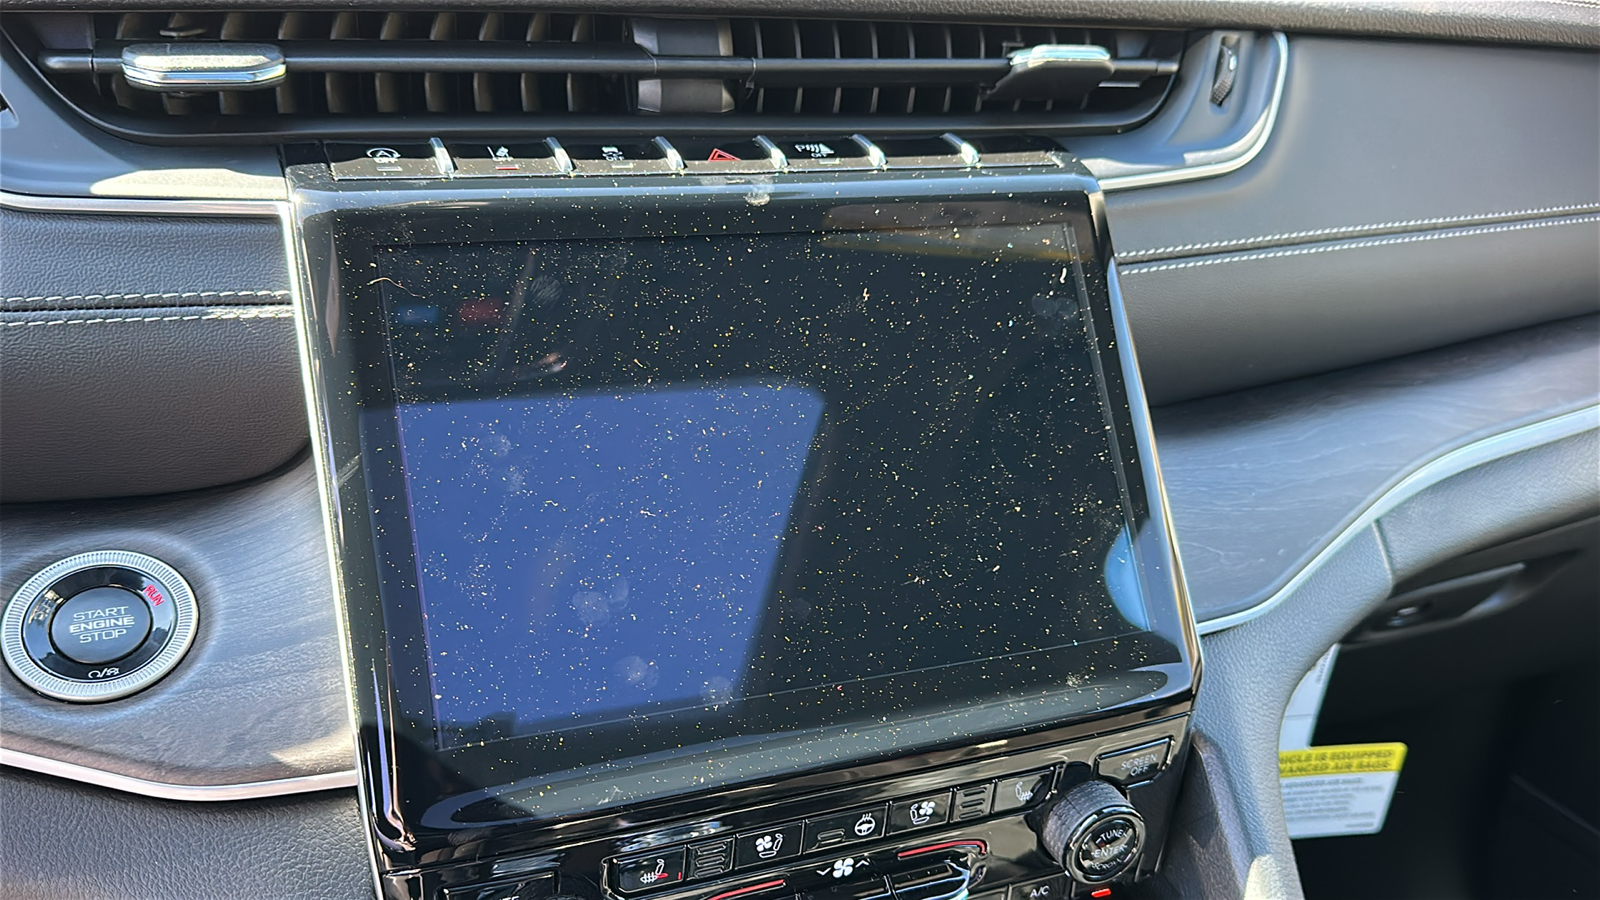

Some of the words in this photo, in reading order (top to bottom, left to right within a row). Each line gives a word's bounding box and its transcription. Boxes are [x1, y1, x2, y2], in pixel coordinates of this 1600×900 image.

[143, 584, 165, 607] RUN
[73, 605, 129, 622] START
[69, 616, 135, 634] ENGINE
[79, 628, 127, 644] STOP
[1121, 753, 1158, 770] SCREEN
[1330, 749, 1393, 760] EQUIPPED
[1130, 766, 1149, 776] OFF
[1332, 761, 1354, 771] AIR
[1100, 829, 1124, 841] TUNE
[1093, 843, 1127, 858] ENTER
[1030, 885, 1050, 898] A/C
